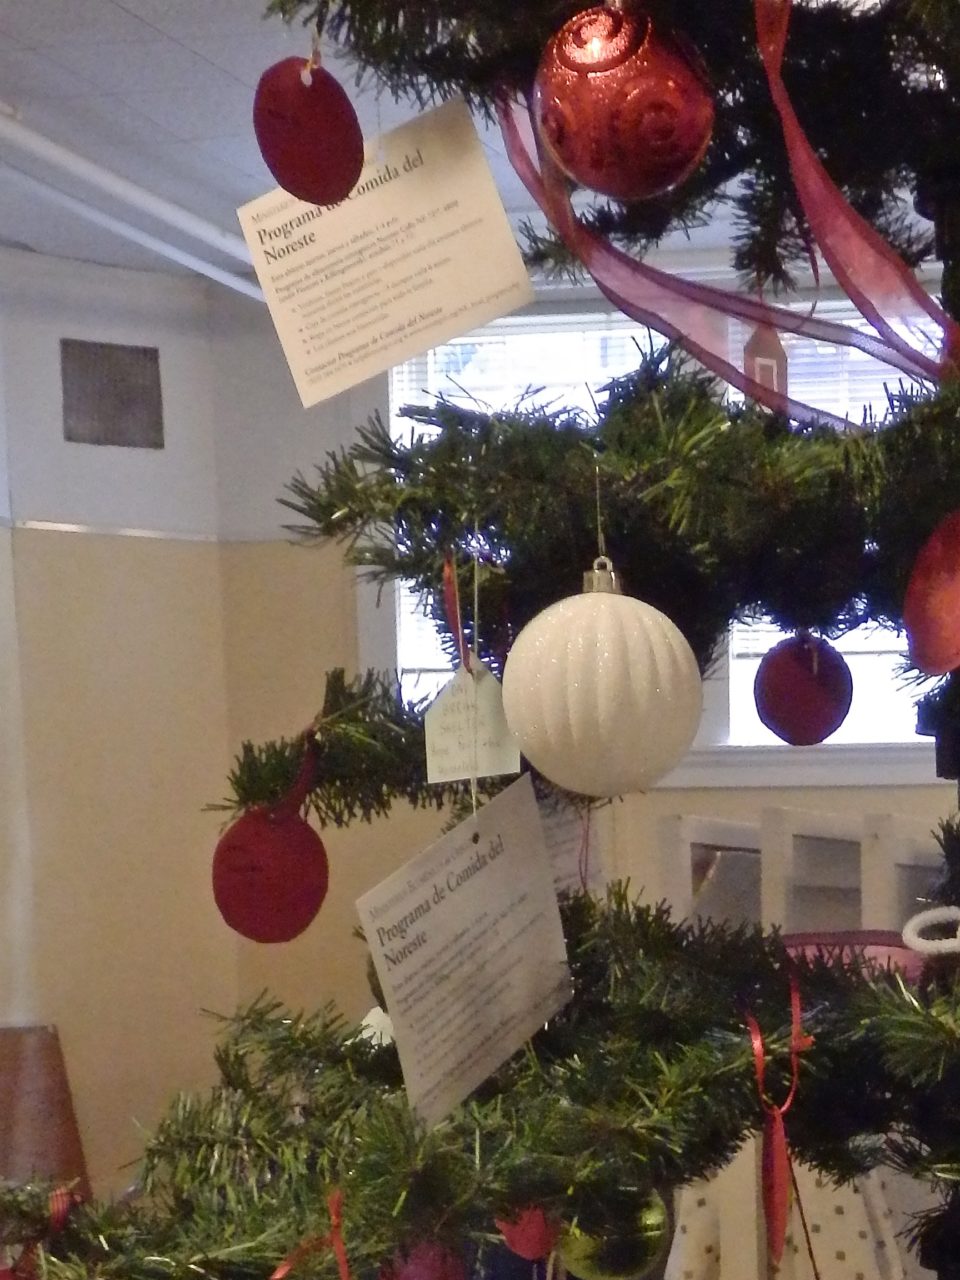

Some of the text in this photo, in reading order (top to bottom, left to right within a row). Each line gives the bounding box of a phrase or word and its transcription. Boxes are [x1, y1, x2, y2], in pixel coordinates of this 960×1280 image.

[256, 207, 323, 246] Programa
[403, 149, 424, 173] del
[263, 231, 316, 265] Noreste
[376, 900, 431, 947] Programa
[433, 884, 445, 904] de
[447, 850, 488, 892] Comida
[488, 834, 504, 860] del
[384, 931, 427, 972] Noreste
